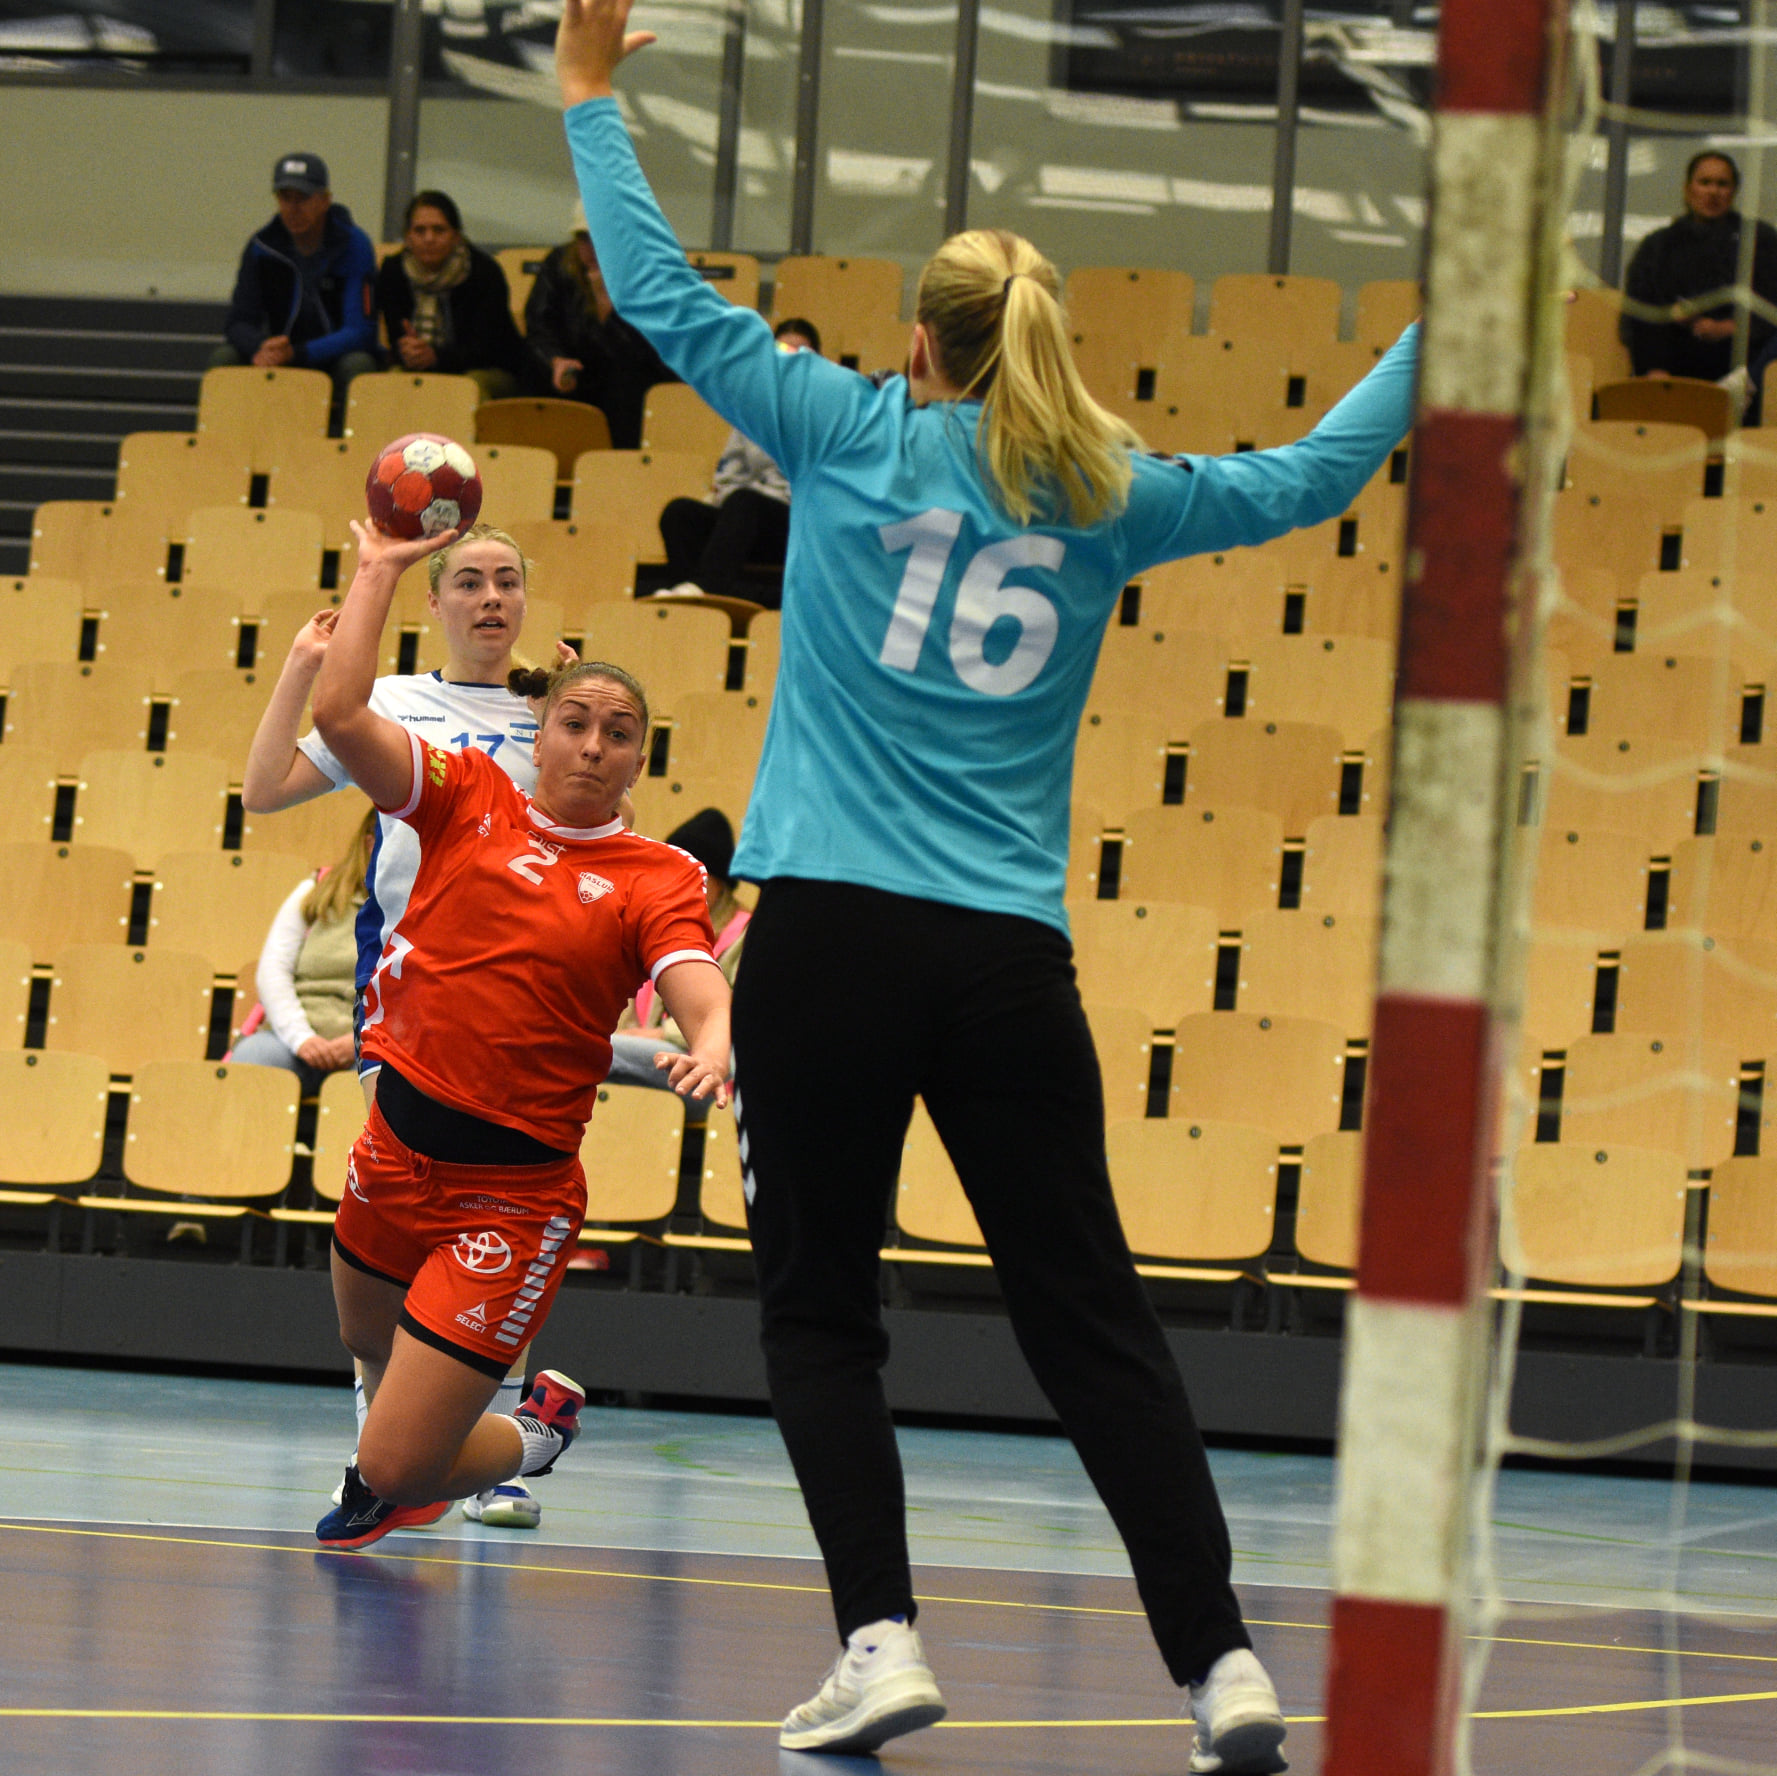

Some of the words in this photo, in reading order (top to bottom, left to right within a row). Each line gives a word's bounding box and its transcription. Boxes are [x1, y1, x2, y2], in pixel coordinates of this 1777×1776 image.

[878, 506, 1066, 697] 16
[409, 714, 446, 723] hummel
[506, 838, 559, 886] 2
[454, 1313, 487, 1334] SELECT
